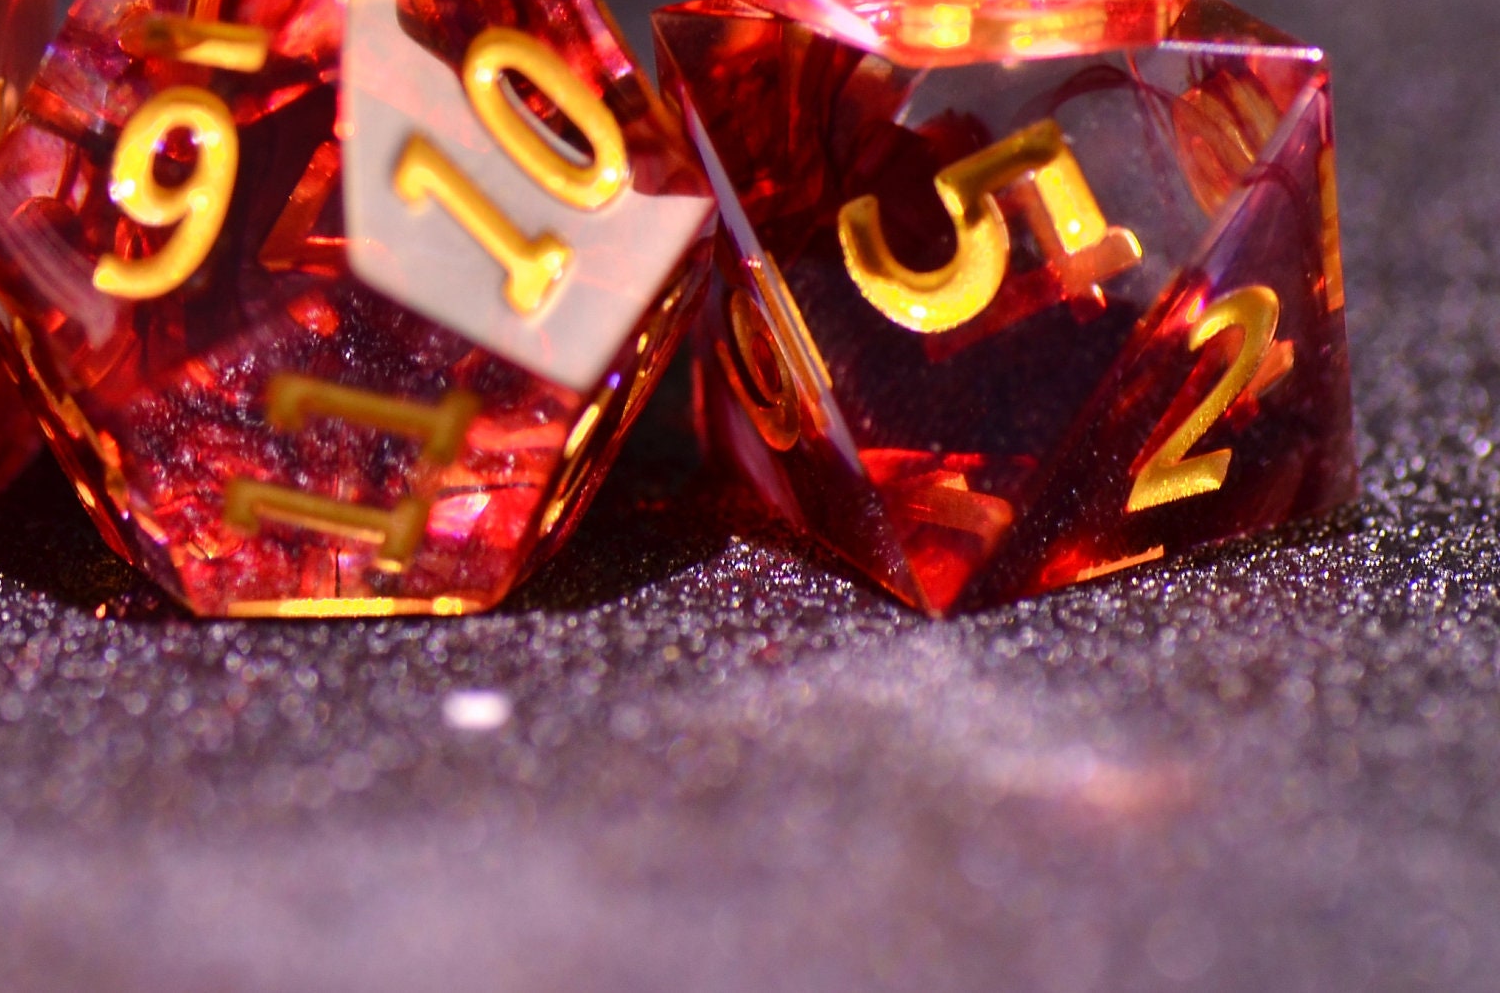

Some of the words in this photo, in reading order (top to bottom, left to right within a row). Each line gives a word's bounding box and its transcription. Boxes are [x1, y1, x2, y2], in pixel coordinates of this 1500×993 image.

[393, 24, 630, 316] 10
[222, 372, 478, 574] 11
[1126, 284, 1280, 512] 2
